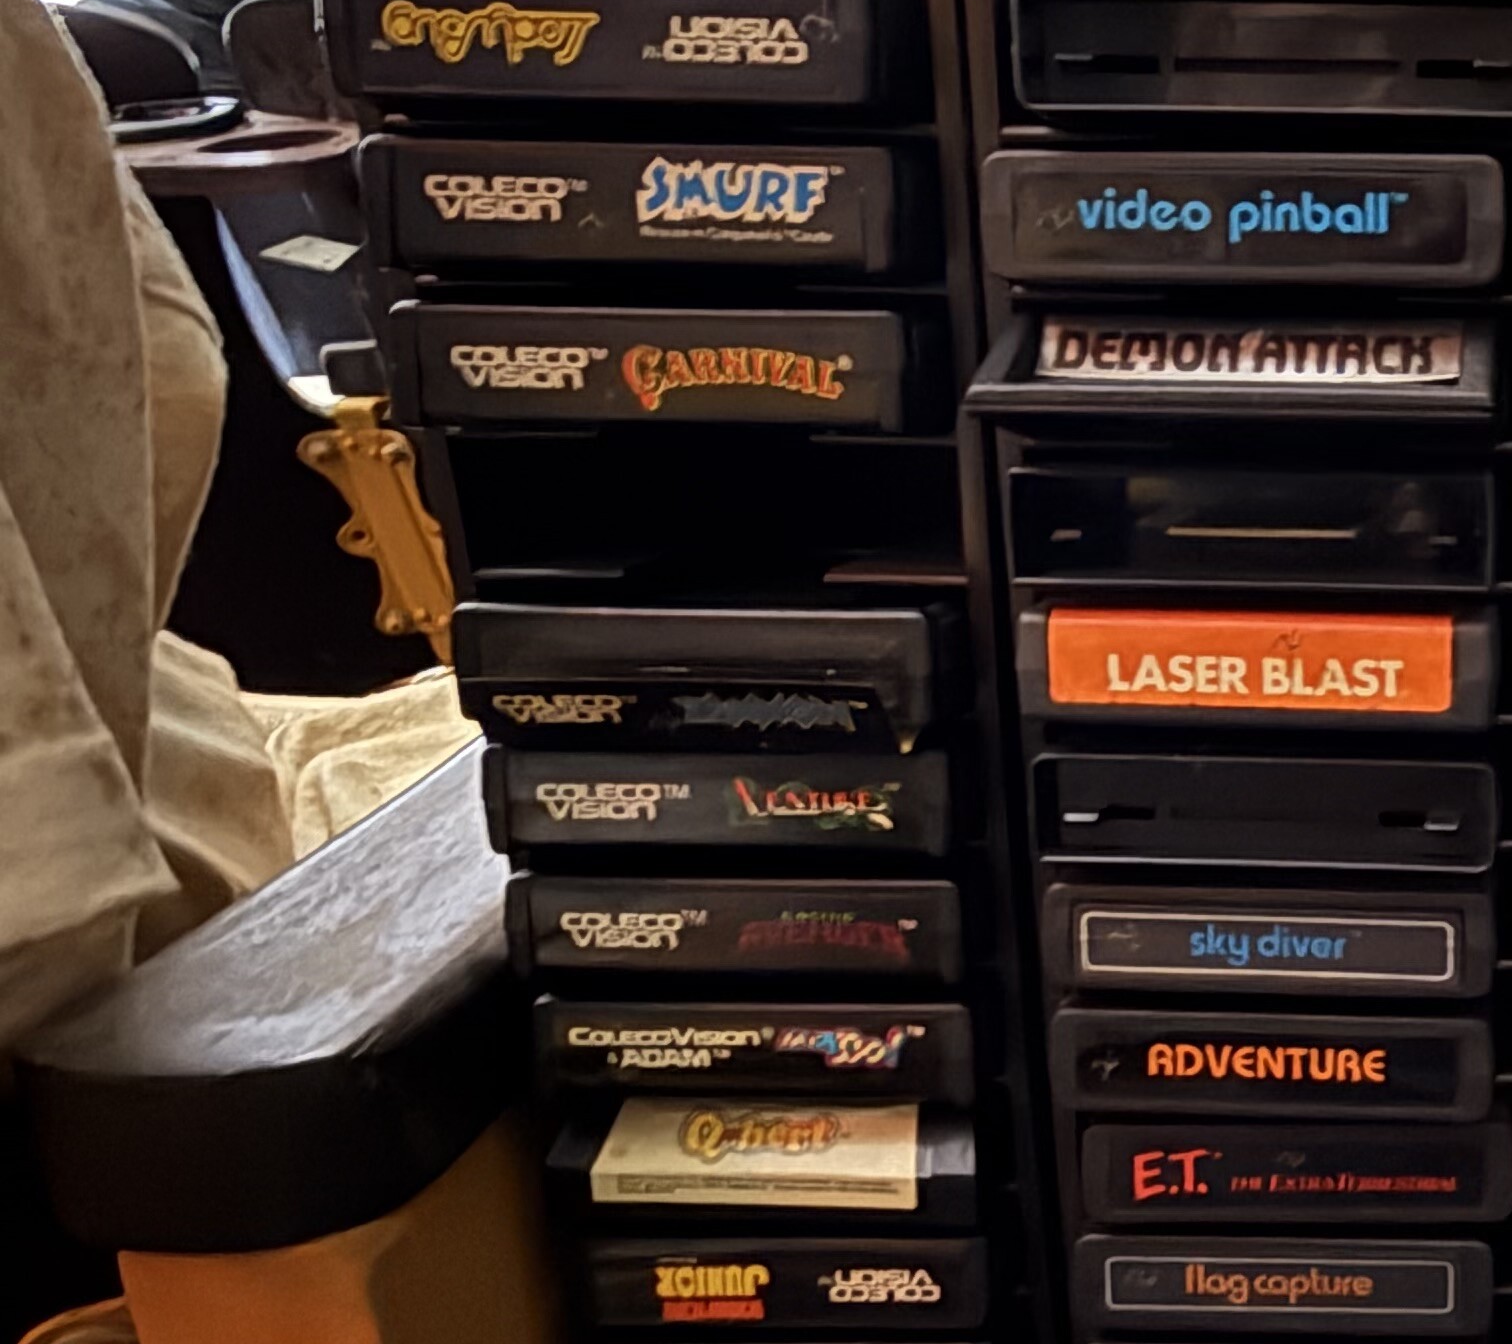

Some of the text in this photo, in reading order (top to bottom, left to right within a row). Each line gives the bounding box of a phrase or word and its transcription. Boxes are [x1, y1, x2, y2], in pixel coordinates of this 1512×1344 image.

[662, 40, 808, 64] COLECO
[425, 175, 568, 198] COLECO
[636, 156, 828, 223] SMURF
[435, 199, 561, 221] VISION
[1077, 188, 1390, 243] video pinball
[450, 345, 587, 367] COLECO
[1053, 328, 1434, 375] DEMON ATTACK
[456, 368, 584, 389] VISION
[621, 344, 845, 410] CARNIVAL
[1107, 655, 1404, 698] LASER BLAST
[536, 784, 661, 800] COLECO
[546, 801, 656, 821] VISION
[560, 913, 681, 929] COLECO
[1190, 924, 1346, 964] sky diver
[1147, 1043, 1386, 1082] ADVENTURE
[1133, 1149, 1208, 1201] E.T.
[655, 1264, 769, 1297] JUNIOR
[829, 1285, 940, 1303] COLECO
[1254, 1268, 1373, 1304] capture
